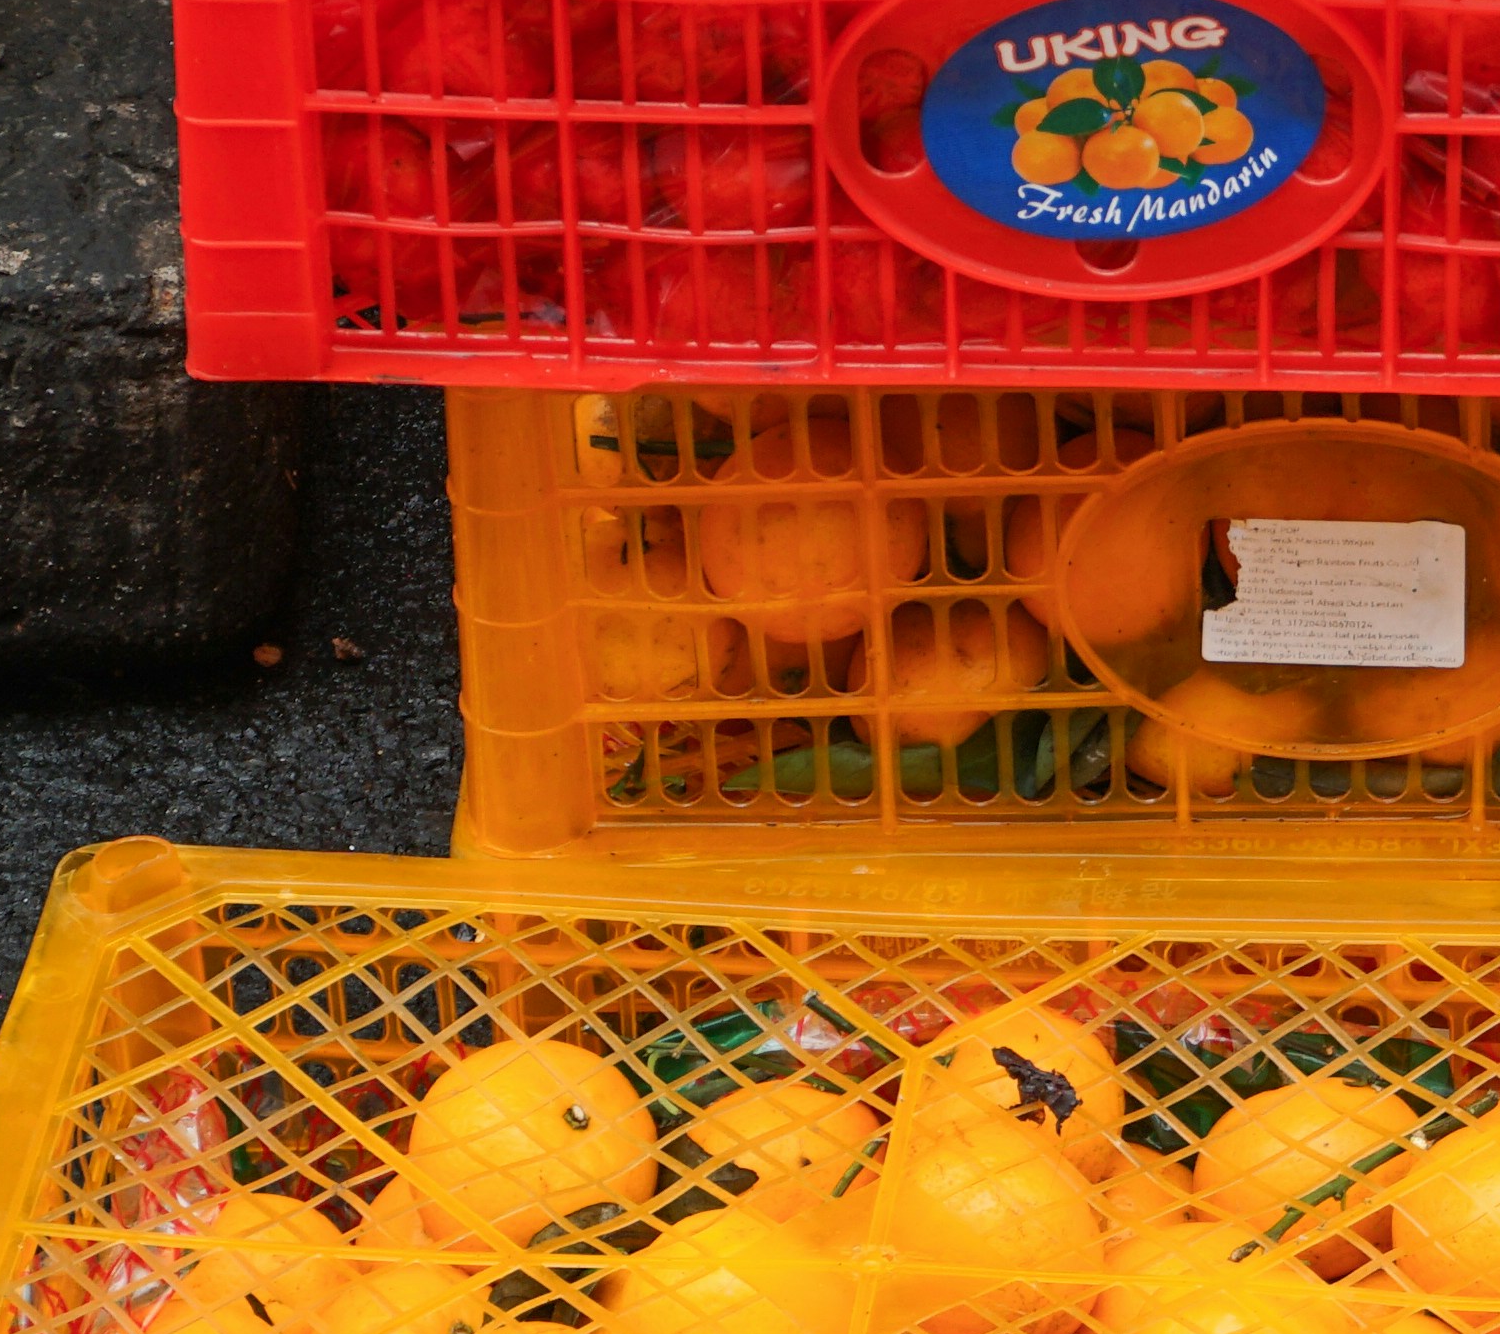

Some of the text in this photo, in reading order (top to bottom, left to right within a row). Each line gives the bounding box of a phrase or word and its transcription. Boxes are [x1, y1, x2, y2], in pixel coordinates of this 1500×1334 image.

[996, 17, 1228, 72] UKING
[1017, 147, 1278, 233] Fresh Mandarin
